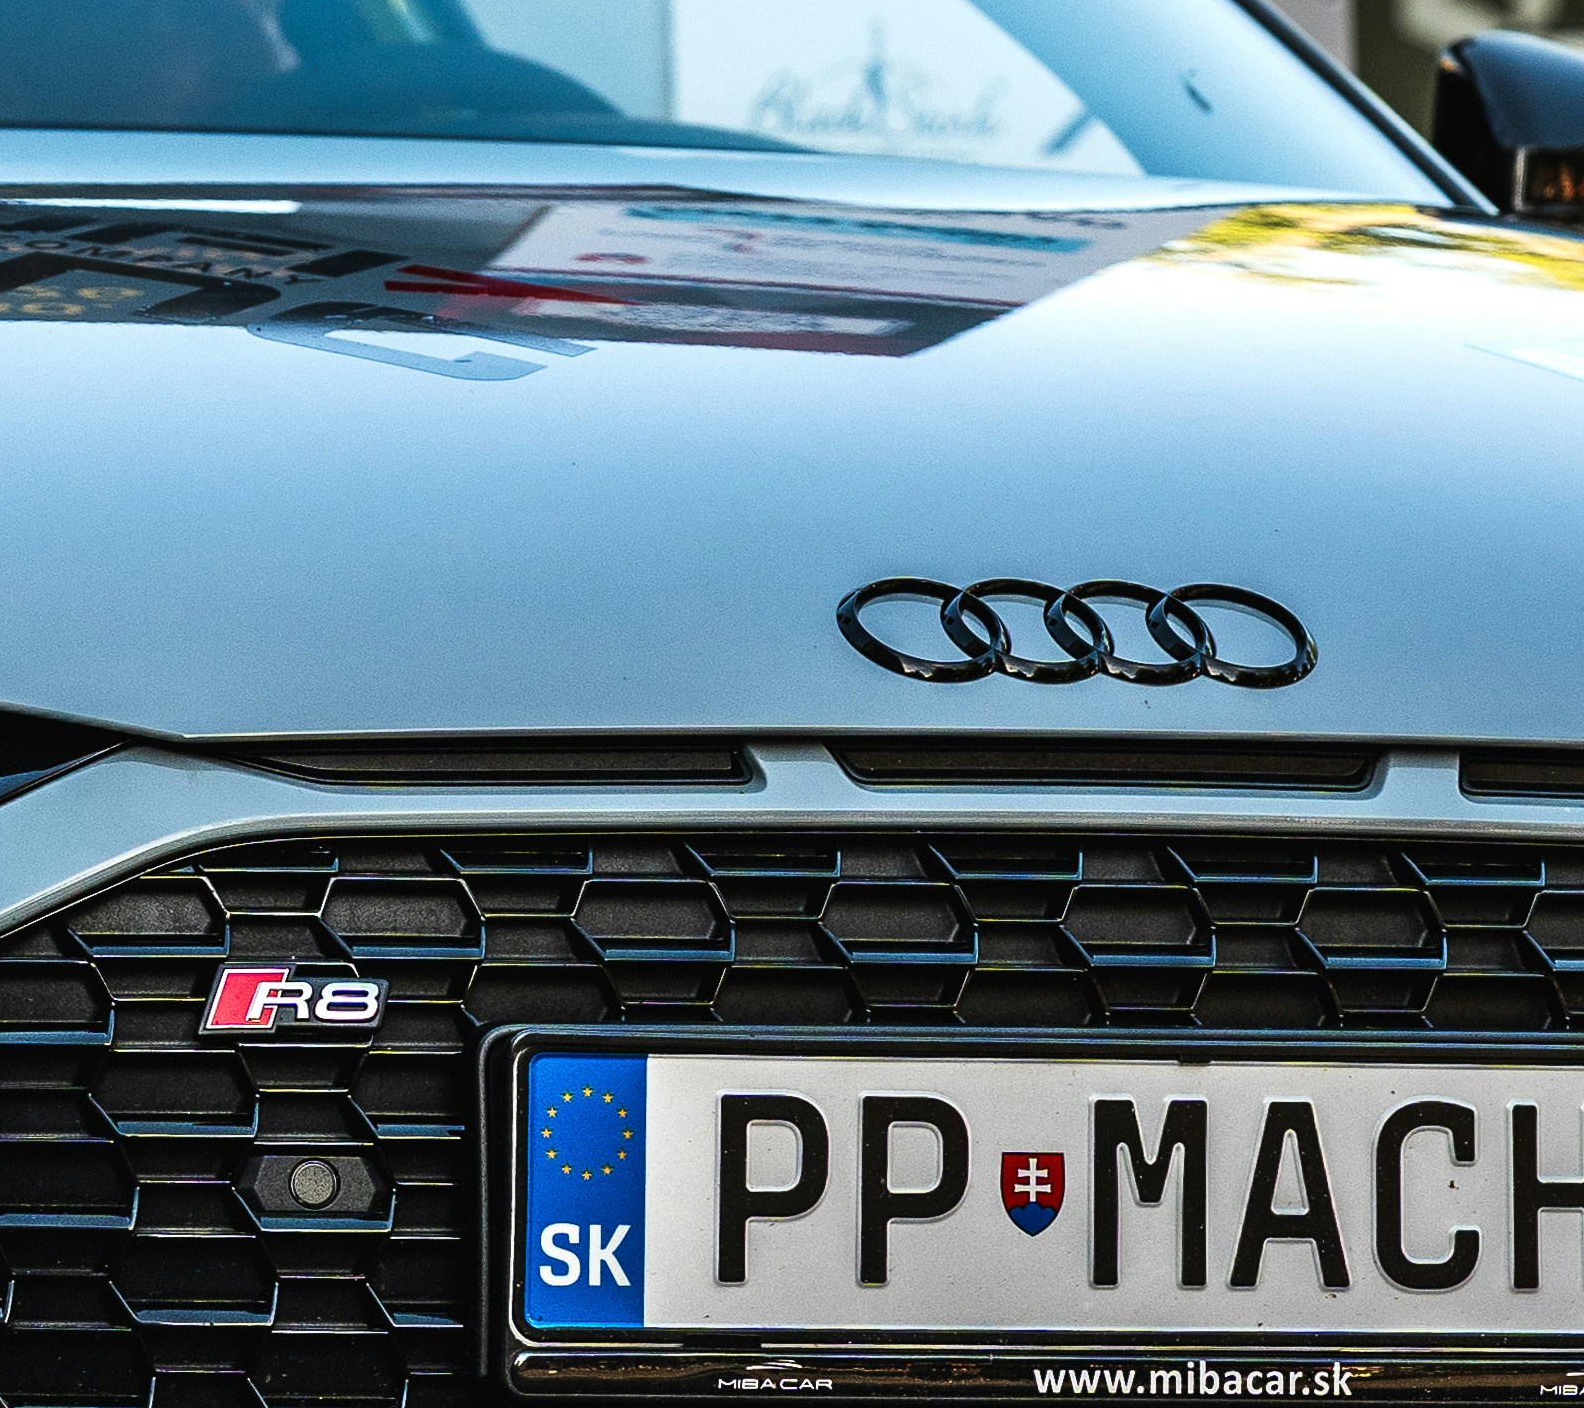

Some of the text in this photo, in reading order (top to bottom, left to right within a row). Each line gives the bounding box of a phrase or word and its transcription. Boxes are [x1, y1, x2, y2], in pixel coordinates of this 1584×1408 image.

[244, 979, 380, 1023] R8
[716, 1090, 972, 1287] PP
[538, 1222, 632, 1288] SK
[1033, 1359, 1353, 1397] www.mibacar.sk
